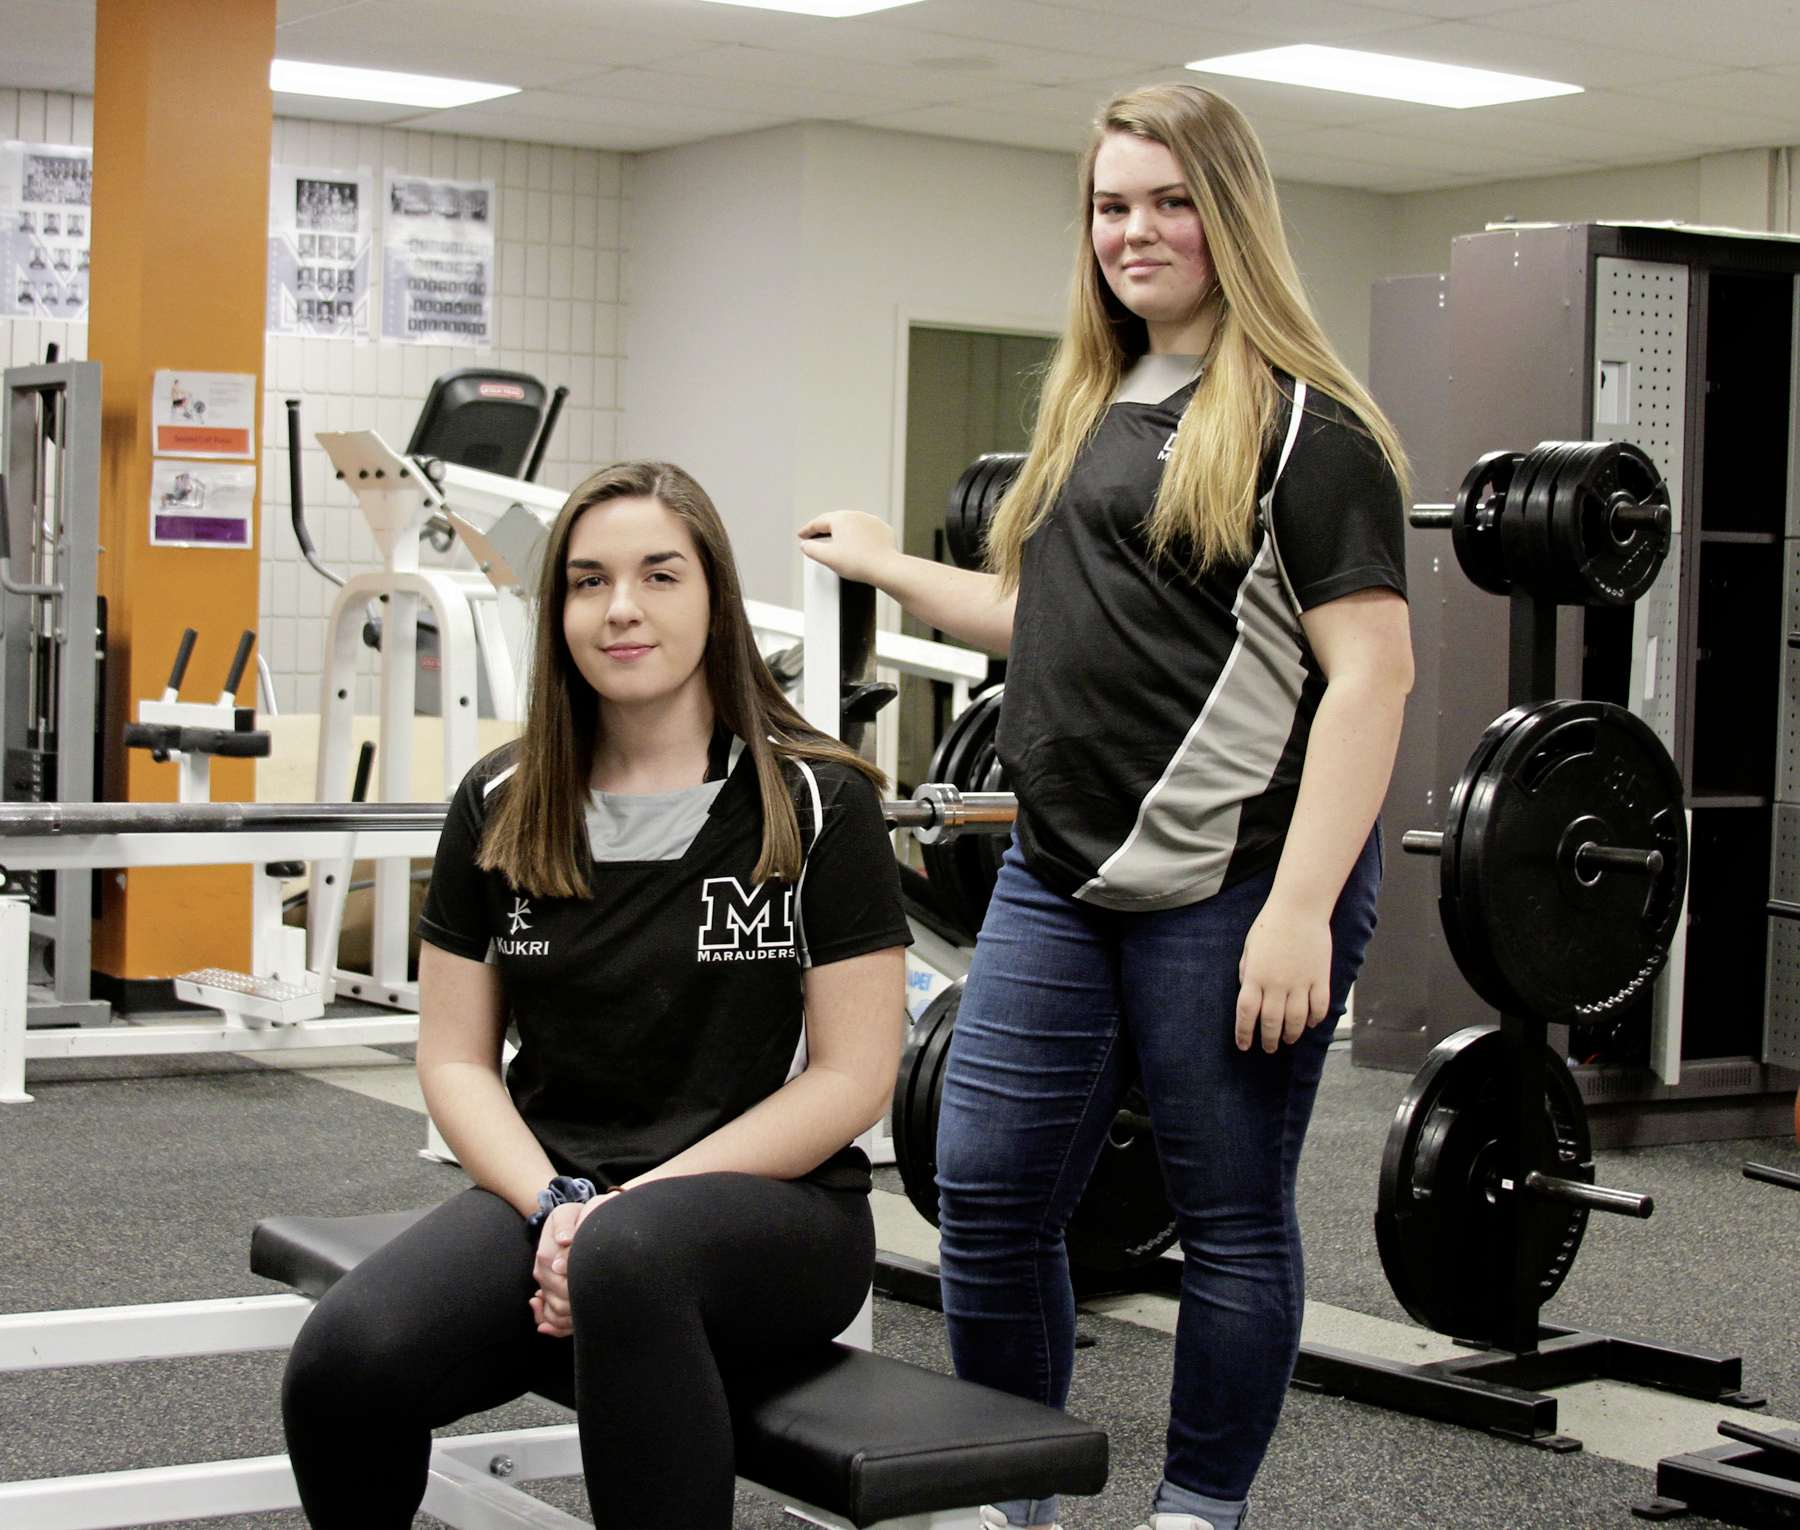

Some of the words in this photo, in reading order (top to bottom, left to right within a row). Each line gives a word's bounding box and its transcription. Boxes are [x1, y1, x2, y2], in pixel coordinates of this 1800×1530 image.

[698, 876, 795, 950] M
[496, 936, 551, 956] KUKRI
[697, 947, 796, 962] MARAUDERS
